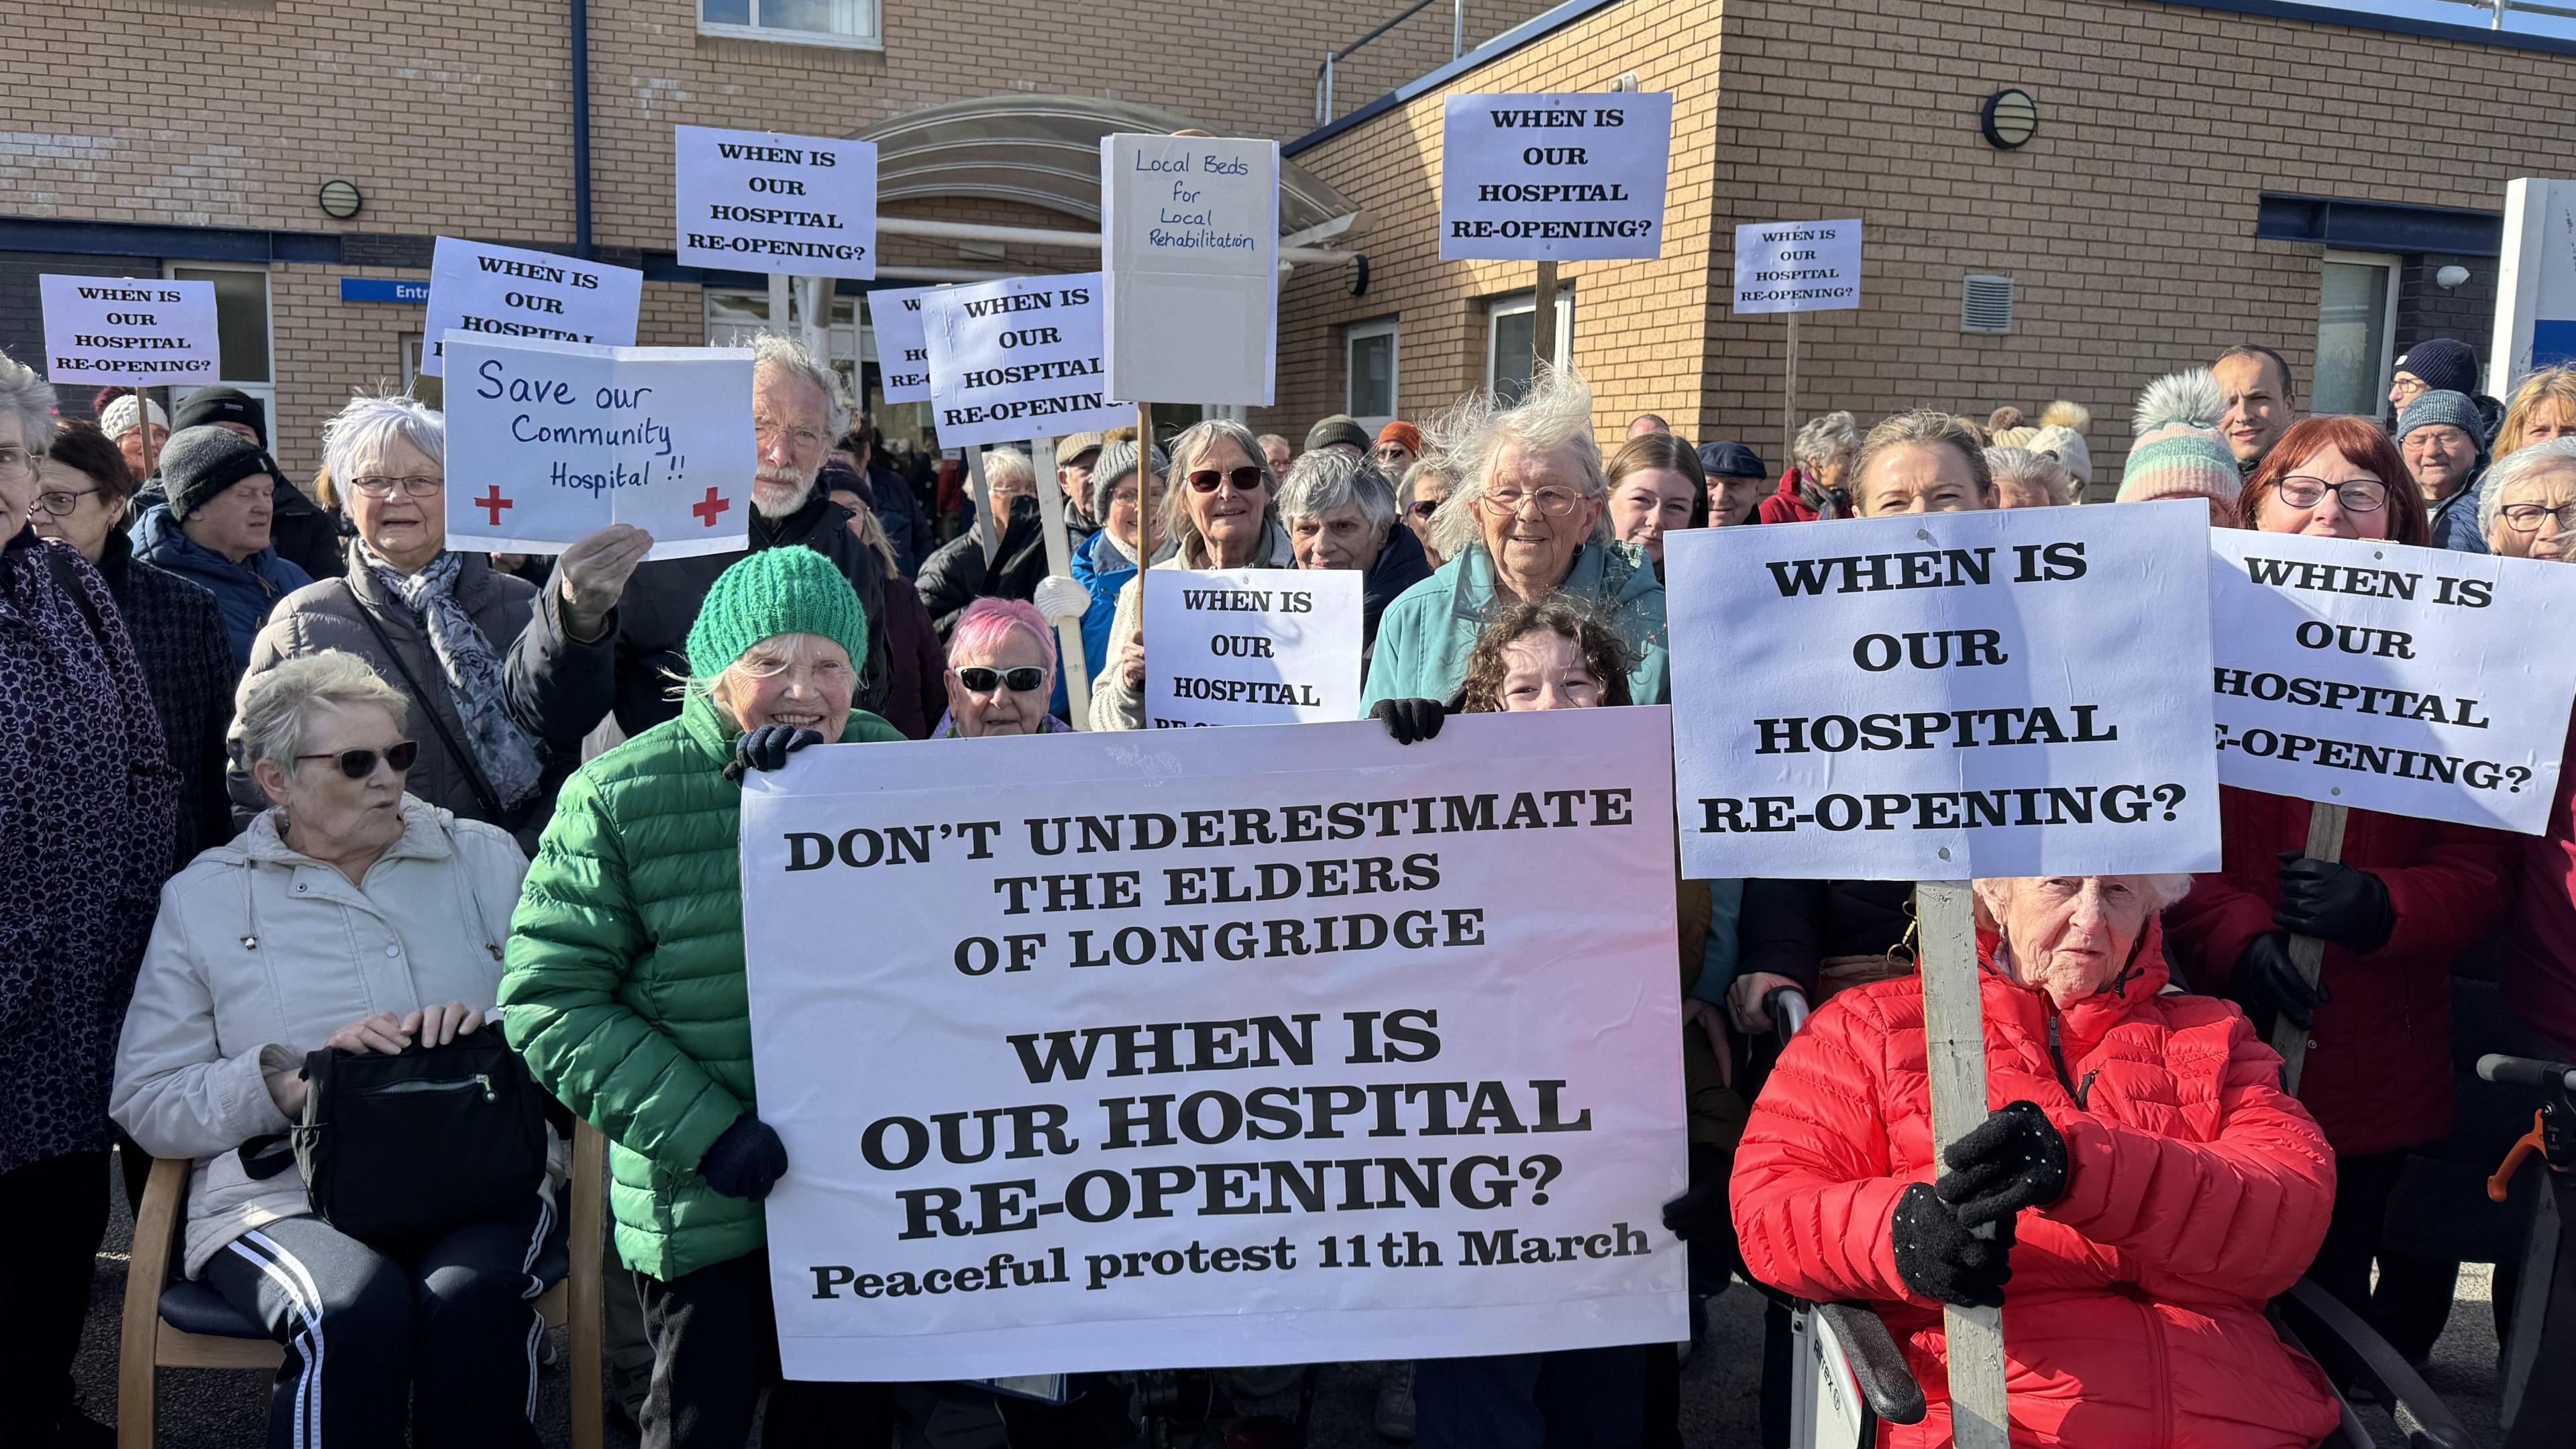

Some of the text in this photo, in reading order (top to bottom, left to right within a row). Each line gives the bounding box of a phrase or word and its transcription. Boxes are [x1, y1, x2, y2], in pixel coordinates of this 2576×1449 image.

[1490, 109, 1623, 127] WHEN IS
[718, 144, 835, 166] WHEN IS
[1136, 150, 1248, 175] Local Beds
[1523, 148, 1588, 165] OUR
[749, 177, 806, 195] OUR
[1479, 184, 1628, 201] HOSPITAL
[710, 205, 843, 229] HOSPITAL
[1161, 208, 1211, 225] Local
[1451, 220, 1652, 238] RE-OPENING?
[688, 233, 865, 260] RE-OPENING?
[1150, 229, 1254, 251] Rehabilitation
[1762, 230, 1835, 242] WHEN IS
[1780, 251, 1816, 260] OUR
[478, 256, 598, 289] WHEN IS
[1756, 269, 1839, 281] HOSPITAL
[78, 287, 180, 302] WHEN IS
[505, 292, 564, 314] OUR
[964, 288, 1089, 317] WHEN IS
[1741, 288, 1853, 301] RE-OPENING?
[107, 313, 157, 325] OUR
[74, 335, 191, 348] HOSPITAL
[1000, 327, 1061, 348] OUR
[56, 358, 211, 372] RE-OPENING?
[963, 358, 1104, 388] HOSPITAL
[477, 360, 652, 409] Save our
[944, 392, 1133, 426] RE-OPENIN
[512, 415, 672, 455] Community
[550, 462, 649, 498] Hospital
[1766, 543, 2086, 596] WHEN IS
[2245, 557, 2493, 608] WHEN IS
[1183, 590, 1311, 612] WHEN IS
[1212, 635, 1274, 658] OUR
[1854, 629, 2008, 672] OUR
[2296, 621, 2415, 659] OUR
[1173, 677, 1320, 706] HOSPITAL
[2214, 667, 2489, 729] HOSPITAL
[1754, 705, 2117, 754] HOSPITAL
[1699, 784, 2186, 833] RE-OPENING?
[784, 788, 1632, 871] DON'T UNDERESTIMATE
[994, 853, 1440, 915] THE ELDERS
[955, 908, 1485, 975] OF LONGRIDGE
[1006, 1009, 1440, 1083] WHEN IS
[861, 1080, 1591, 1171] OUR HOSPITAL
[896, 1155, 1562, 1240] RE-OPENING?
[810, 1222, 1651, 1299] Peaceful protest 11th March
